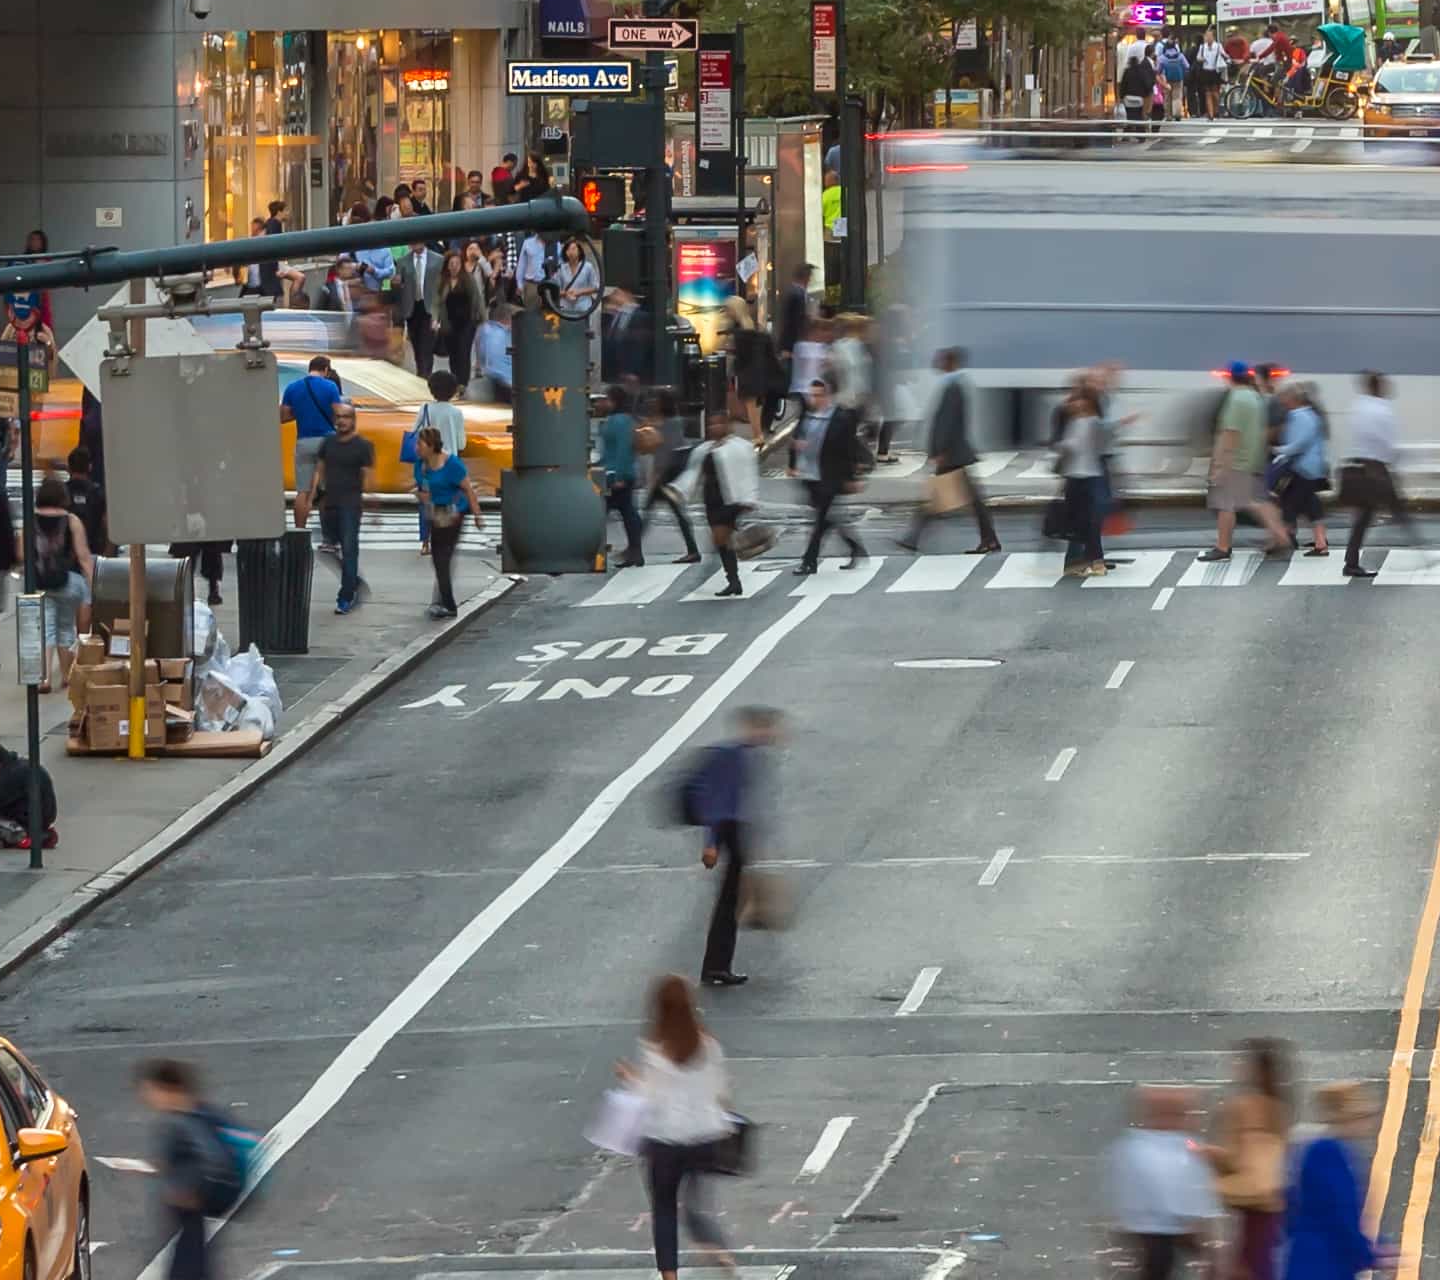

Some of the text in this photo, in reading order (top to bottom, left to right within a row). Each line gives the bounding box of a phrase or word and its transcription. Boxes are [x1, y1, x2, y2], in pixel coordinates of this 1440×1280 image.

[548, 21, 585, 34] NAILS
[622, 28, 683, 41] ONE WAY
[512, 68, 630, 88] Madison Ave
[515, 632, 728, 662] BUS
[400, 673, 694, 709] ONLY
